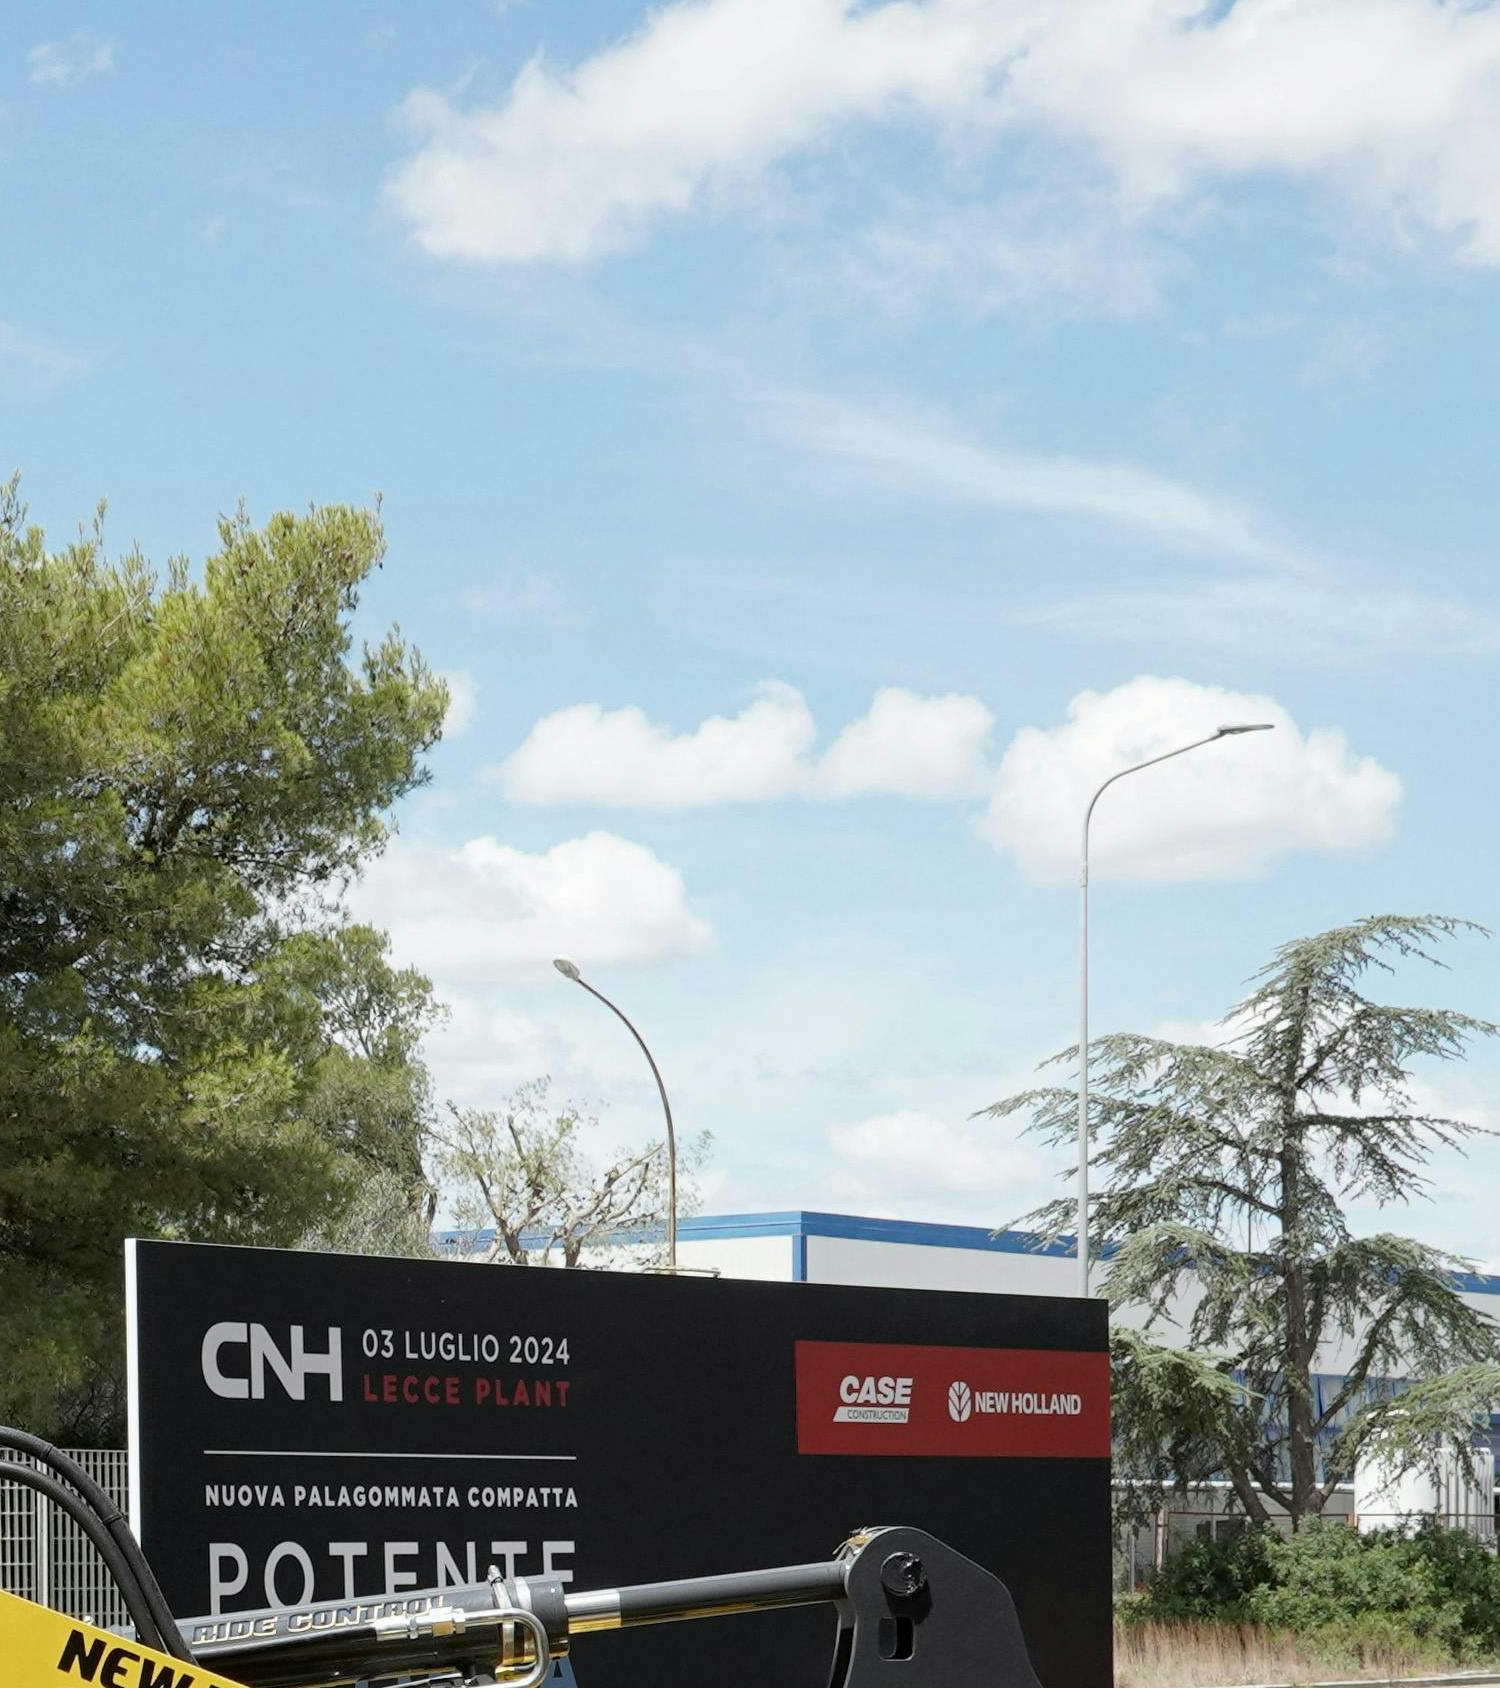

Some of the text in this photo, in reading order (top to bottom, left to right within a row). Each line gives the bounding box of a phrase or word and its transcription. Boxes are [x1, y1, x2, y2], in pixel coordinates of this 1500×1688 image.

[201, 1321, 344, 1401] CNH
[361, 1328, 571, 1365] 03 LUGLIO 2024
[361, 1373, 571, 1408] LECCE PLANT
[839, 1374, 914, 1405] CASE
[974, 1391, 1082, 1415] NEW HOLLAND
[846, 1408, 907, 1422] CONSTRUCTION
[204, 1483, 579, 1509] NUOVA PALAGOMMATA COMPATTA
[191, 1616, 279, 1645] RIDE
